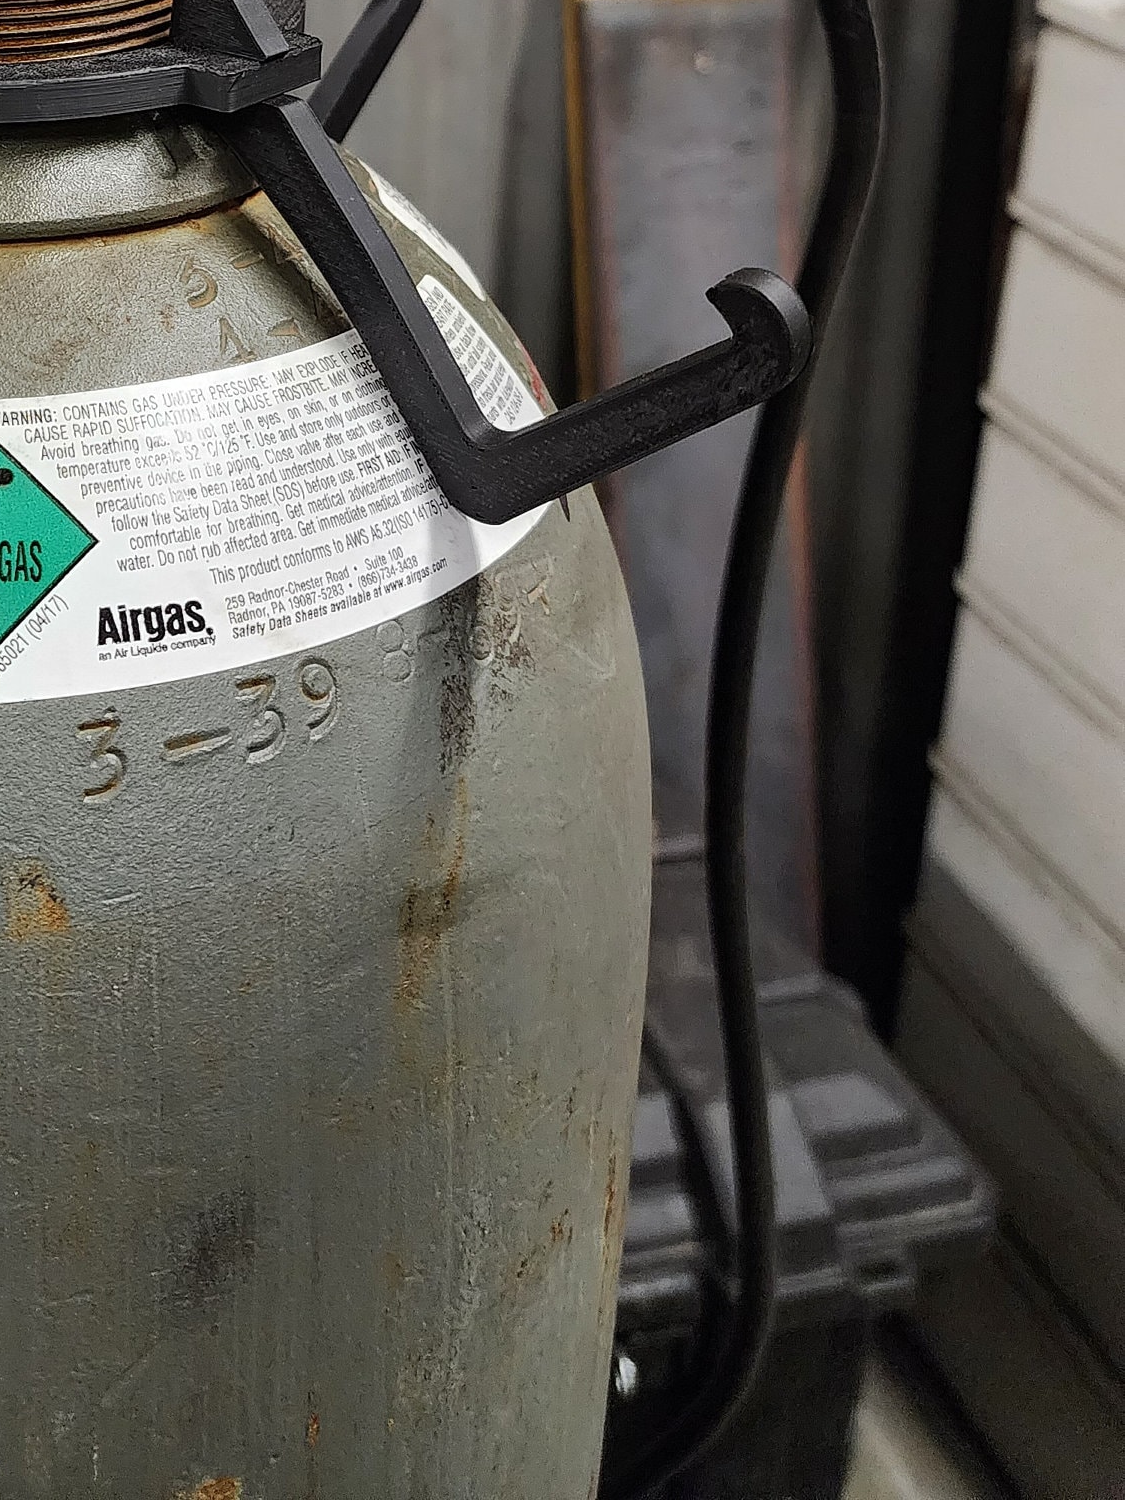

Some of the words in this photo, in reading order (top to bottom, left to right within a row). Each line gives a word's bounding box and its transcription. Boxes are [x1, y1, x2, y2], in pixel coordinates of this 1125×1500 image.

[23, 424, 68, 444] CAUSE
[72, 419, 112, 438] RAPID
[116, 406, 205, 433] SUFFOCATION.
[205, 400, 231, 419] MAY
[234, 392, 272, 413] CAUSE
[271, 377, 330, 404] FROSTBITE.
[326, 368, 349, 388] MAY
[62, 399, 127, 421] CONTAINS
[132, 394, 158, 413] GAS
[271, 367, 295, 385] MAY
[295, 354, 341, 378] EXPLODE
[349, 342, 370, 361] HEA
[40, 441, 75, 460] Avoid
[80, 436, 139, 456] breathing
[256, 411, 285, 429] eyes,
[303, 398, 328, 415] skin,
[56, 458, 131, 479] temperature
[254, 431, 277, 447] Use
[277, 422, 298, 441] and
[298, 419, 323, 436] store
[324, 410, 344, 428] only
[344, 394, 381, 421] outdoors
[80, 473, 143, 499] preventive
[147, 467, 186, 487] device
[225, 454, 263, 476] piping.
[264, 446, 294, 464] Close
[295, 438, 321, 456] valve
[322, 432, 345, 448] after
[345, 421, 367, 441] each
[95, 491, 166, 518] precautions
[198, 481, 228, 498] been
[230, 472, 255, 492] read
[256, 467, 277, 486] and
[278, 451, 338, 481] understood.
[336, 447, 357, 463] Use
[356, 438, 380, 459] only
[374, 431, 395, 450] with
[110, 513, 148, 532] follow
[151, 509, 171, 525] the
[172, 503, 209, 522] Safety
[211, 497, 239, 515] Data
[239, 489, 272, 510] Sheet
[271, 480, 305, 506] (SDS)
[303, 474, 337, 493] before
[337, 468, 358, 484] use.
[356, 455, 384, 477] FIRST
[129, 524, 201, 550] comfortable
[225, 509, 283, 533] breathing.
[285, 501, 305, 519] Get
[306, 488, 346, 514] medical
[347, 467, 415, 502] advice/attention.
[116, 554, 154, 571] water.
[177, 544, 198, 562] not
[200, 540, 221, 558] rub
[223, 529, 268, 554] affected
[269, 527, 297, 544] area.
[297, 518, 316, 536] Get
[315, 504, 367, 531] immediate
[367, 488, 401, 515] medical
[208, 565, 235, 584] This
[237, 554, 281, 583] product
[282, 543, 332, 568] conforms
[345, 527, 369, 550] AWS
[25, 593, 70, 640] (04/17)
[224, 593, 245, 610] 259
[247, 576, 323, 604] Radnor-Chester
[324, 565, 349, 584] Road
[363, 554, 387, 570] Suite
[227, 606, 269, 625] Radnor,
[287, 582, 344, 609] 19087-5283
[357, 554, 418, 594] (866)734-3438
[232, 621, 265, 639] Safety
[268, 613, 291, 630] Data
[295, 604, 327, 623] Sheets
[330, 590, 371, 612] available
[383, 557, 447, 594] www.airgas.com
[99, 651, 112, 661] an
[114, 647, 129, 660] Air
[131, 641, 168, 659] Liquide
[170, 634, 217, 651] company
